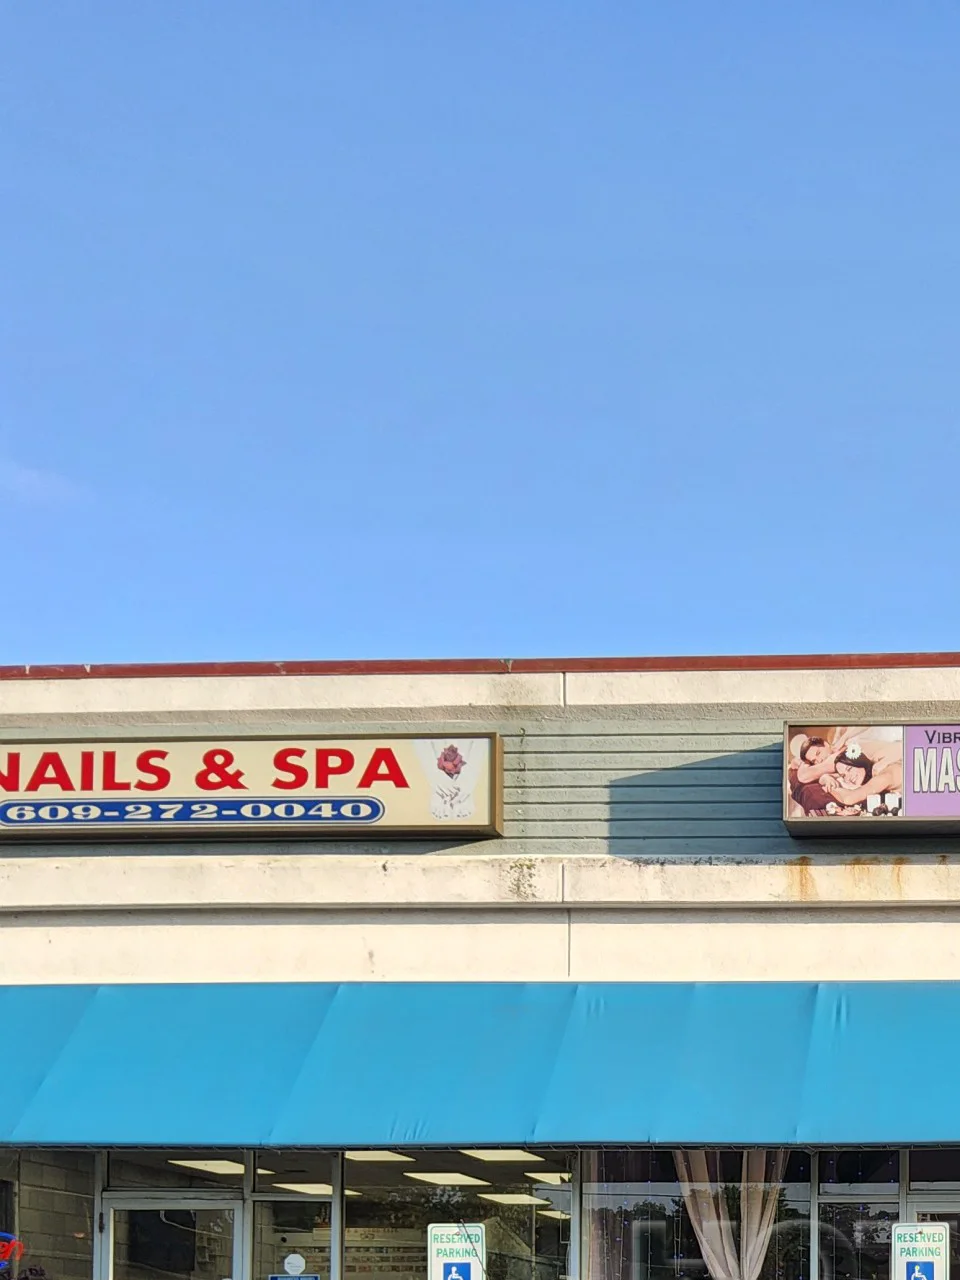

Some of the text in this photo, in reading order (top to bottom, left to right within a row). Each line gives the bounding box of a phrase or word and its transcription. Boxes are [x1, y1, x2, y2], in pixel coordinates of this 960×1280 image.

[194, 748, 249, 790] &
[271, 747, 410, 790] SPA
[6, 802, 374, 822] 609-272-0040
[433, 1233, 480, 1244] RESERVED
[897, 1232, 944, 1243] RESERVED
[436, 1248, 478, 1258] PARKING
[900, 1247, 941, 1257] PARKING
